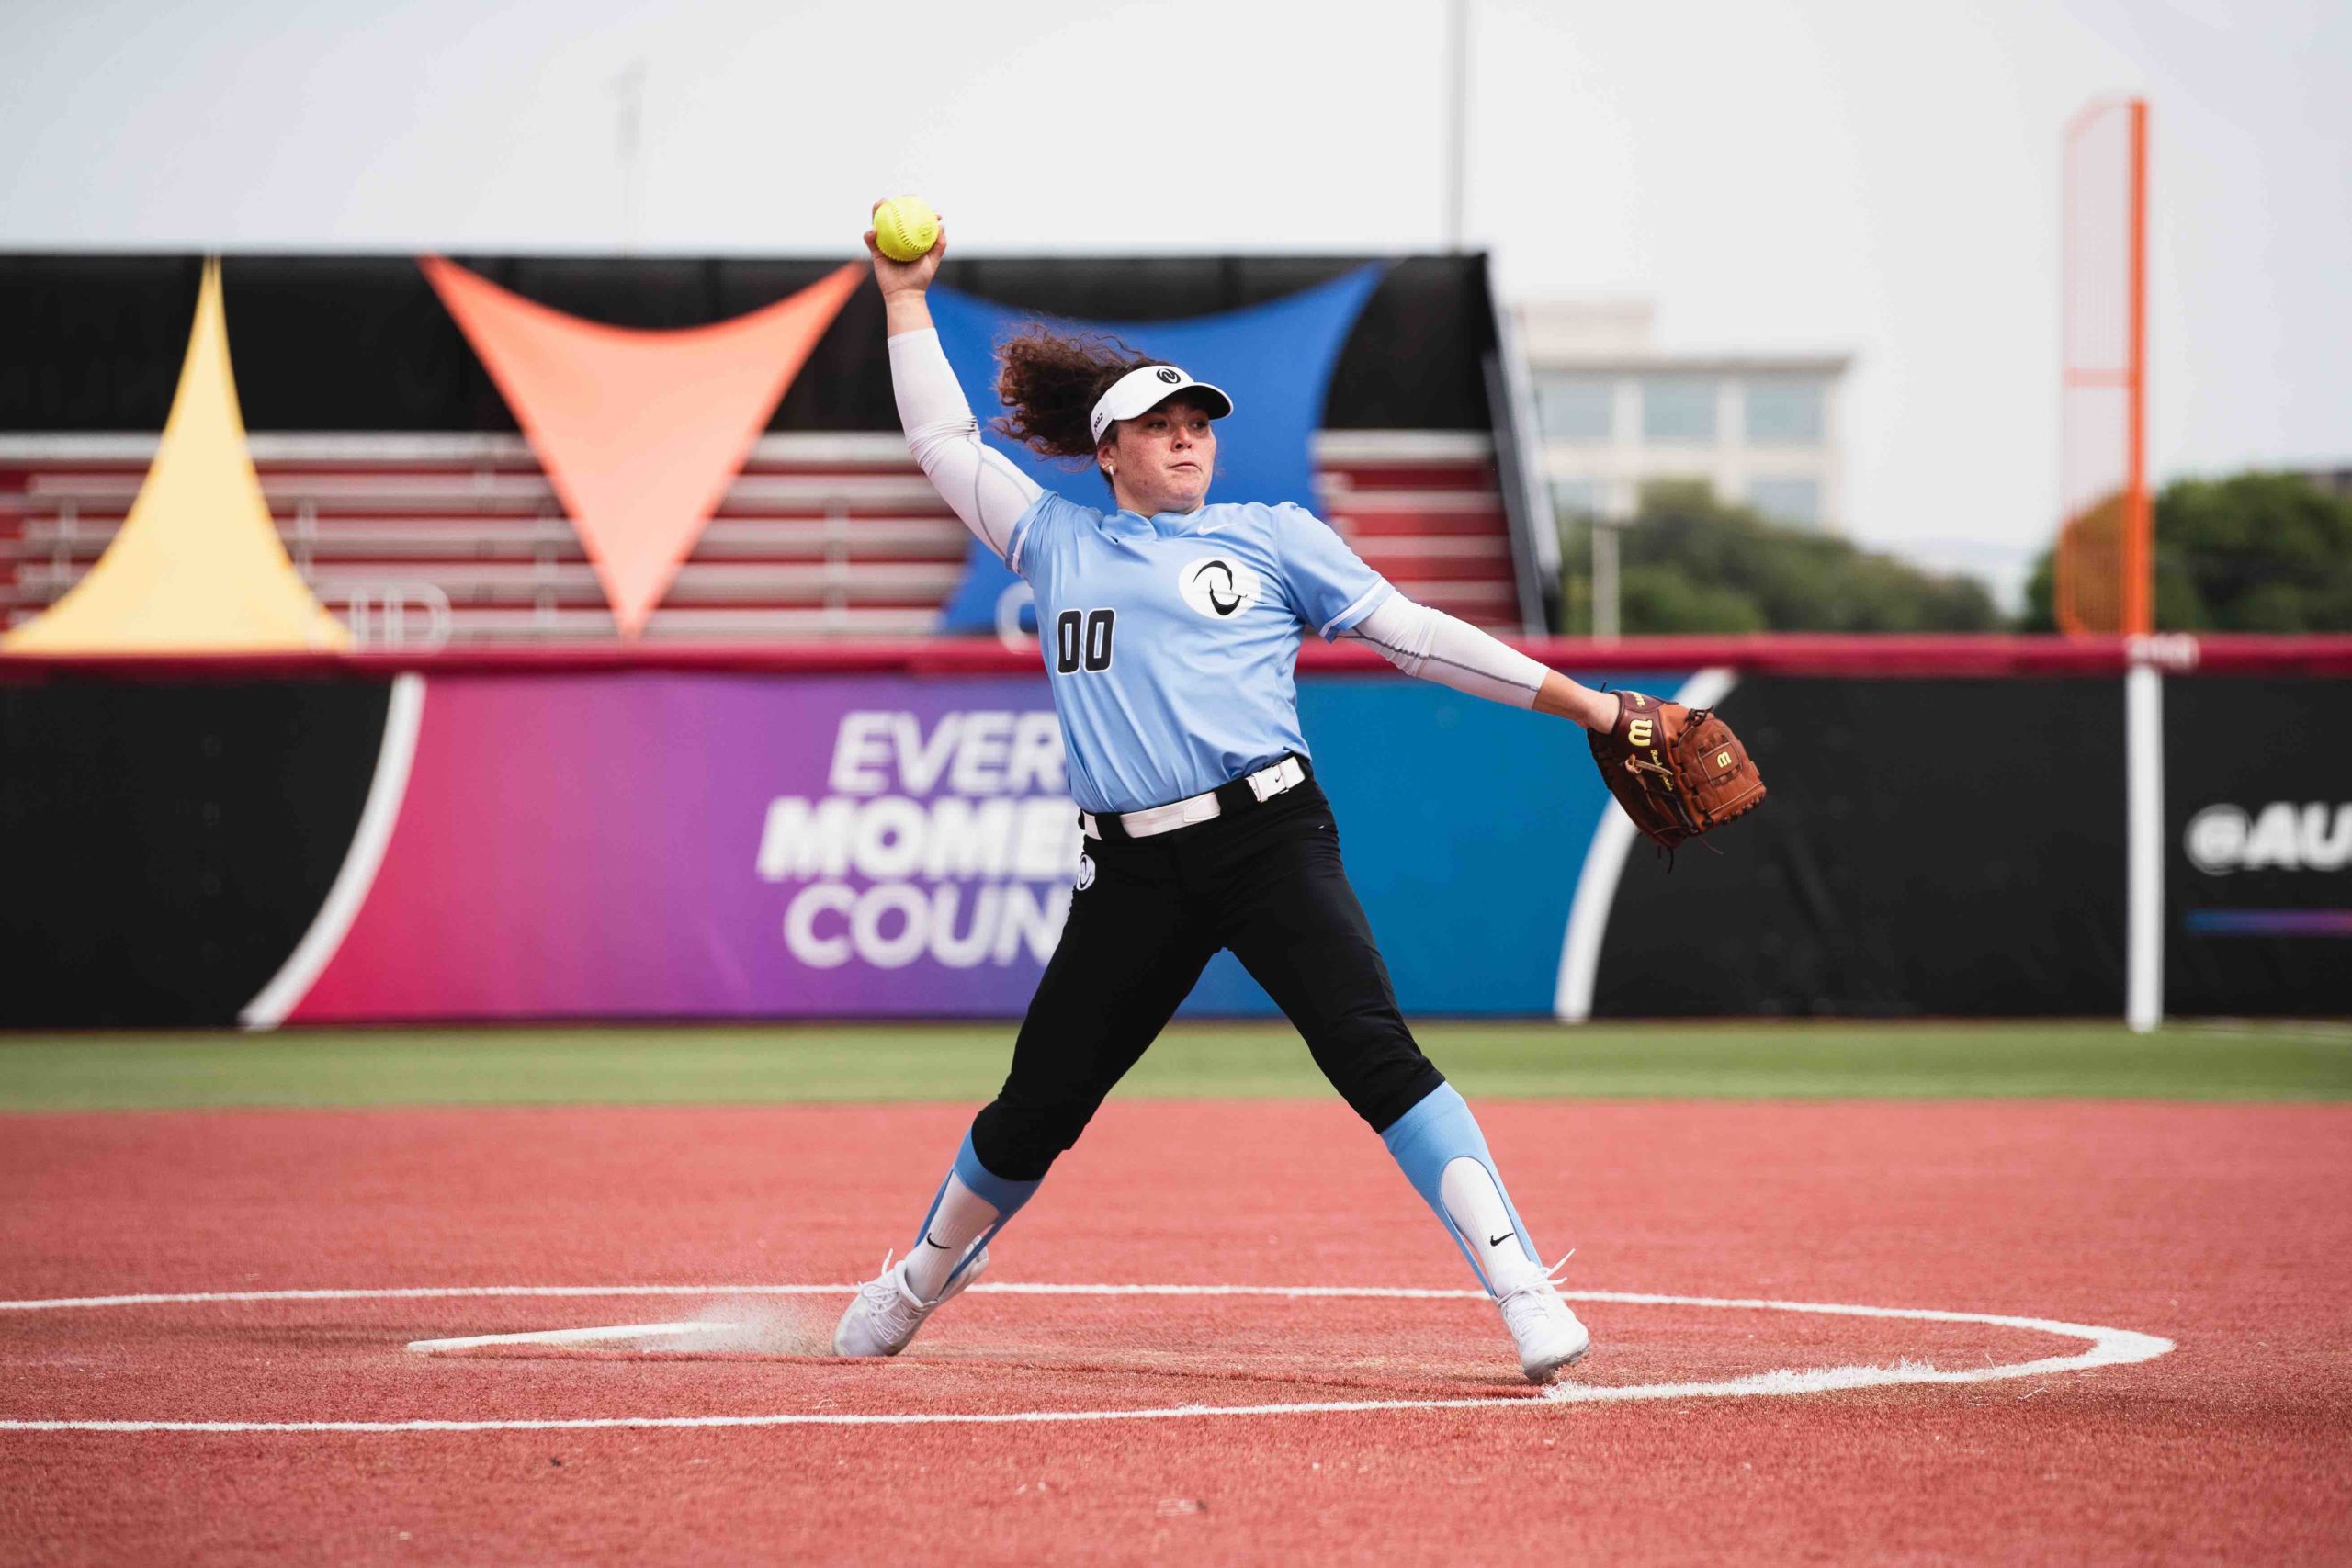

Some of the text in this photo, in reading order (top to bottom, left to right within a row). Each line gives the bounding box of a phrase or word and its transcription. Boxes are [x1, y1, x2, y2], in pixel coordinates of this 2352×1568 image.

[1057, 607, 1115, 675] 00
[829, 710, 1069, 795] EVER
[755, 795, 1084, 882] MOME
[2183, 802, 2352, 875] @AU
[784, 882, 1073, 969] COUN
